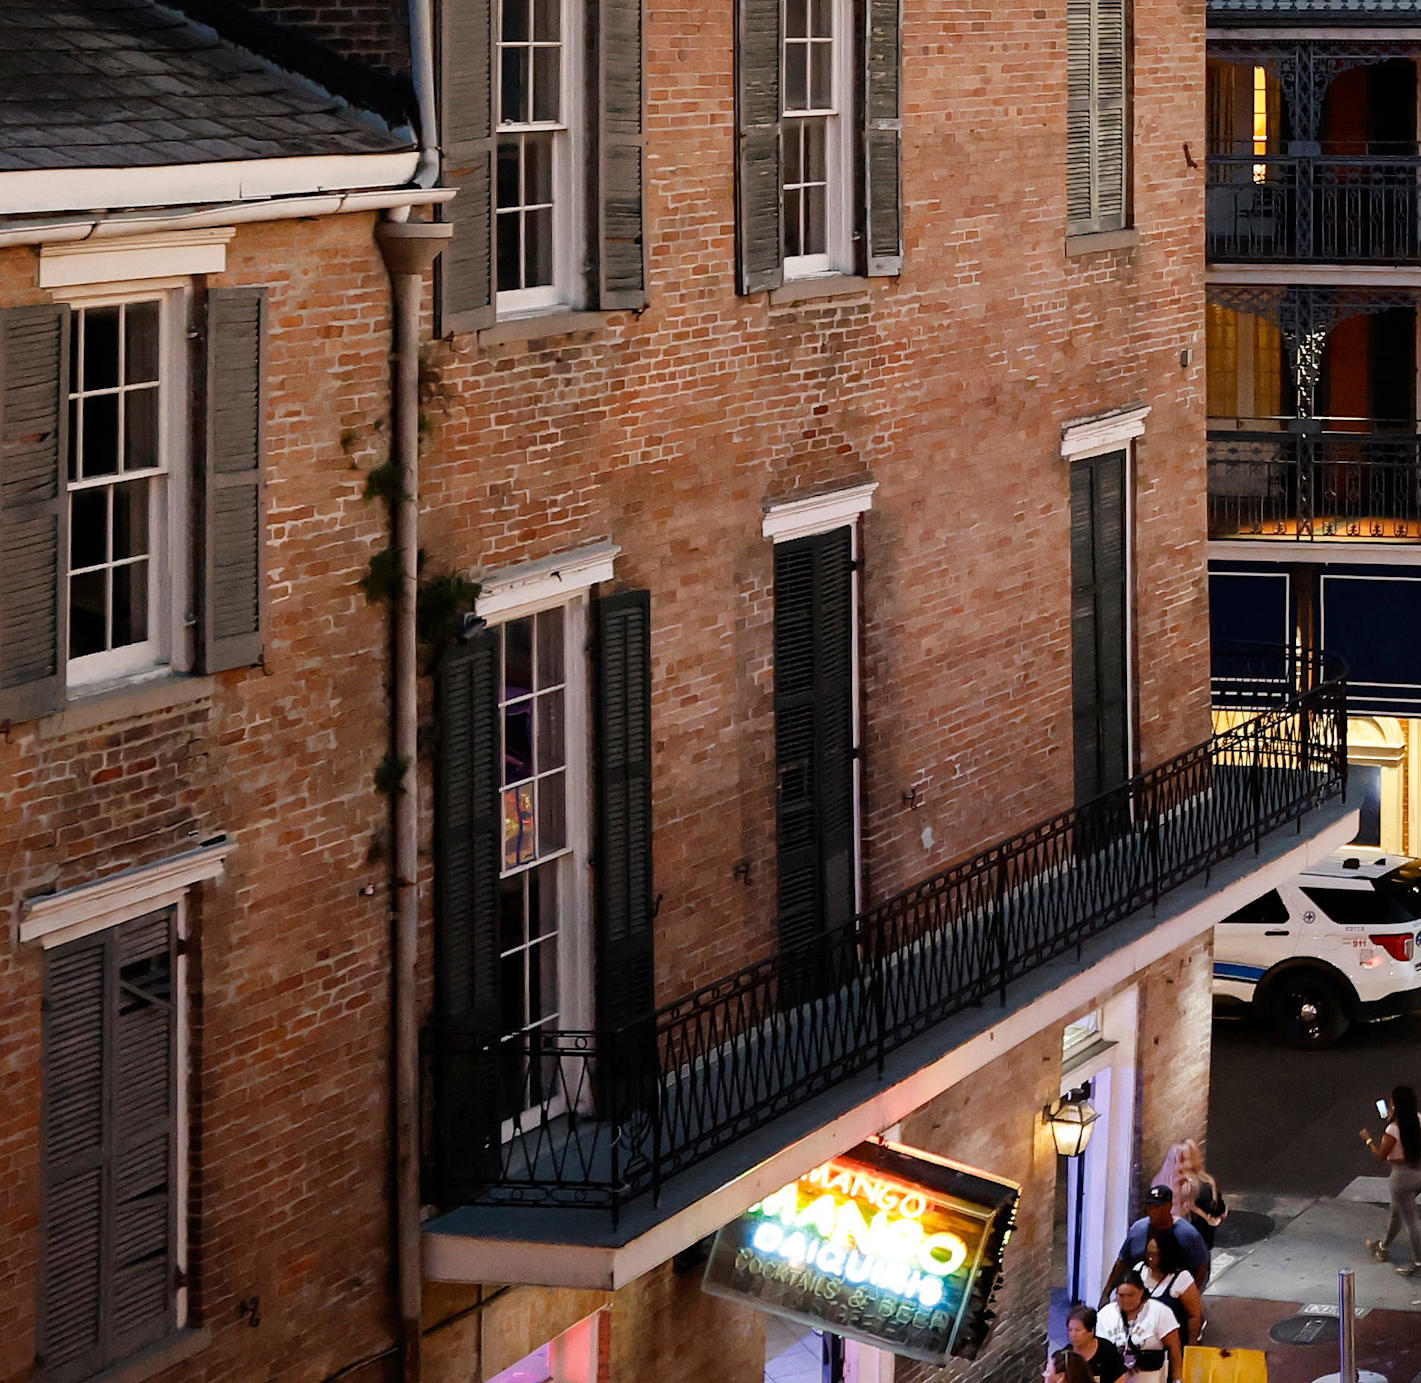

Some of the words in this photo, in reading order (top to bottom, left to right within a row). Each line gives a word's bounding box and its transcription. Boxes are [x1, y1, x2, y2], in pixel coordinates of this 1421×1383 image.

[748, 1182, 968, 1276] MANGO
[801, 1165, 927, 1218] MANGO
[734, 1247, 843, 1301] COCKTAILS
[848, 1285, 868, 1309] &
[877, 1295, 950, 1331] BEER
[752, 1221, 944, 1307] DAIQUIRIS
